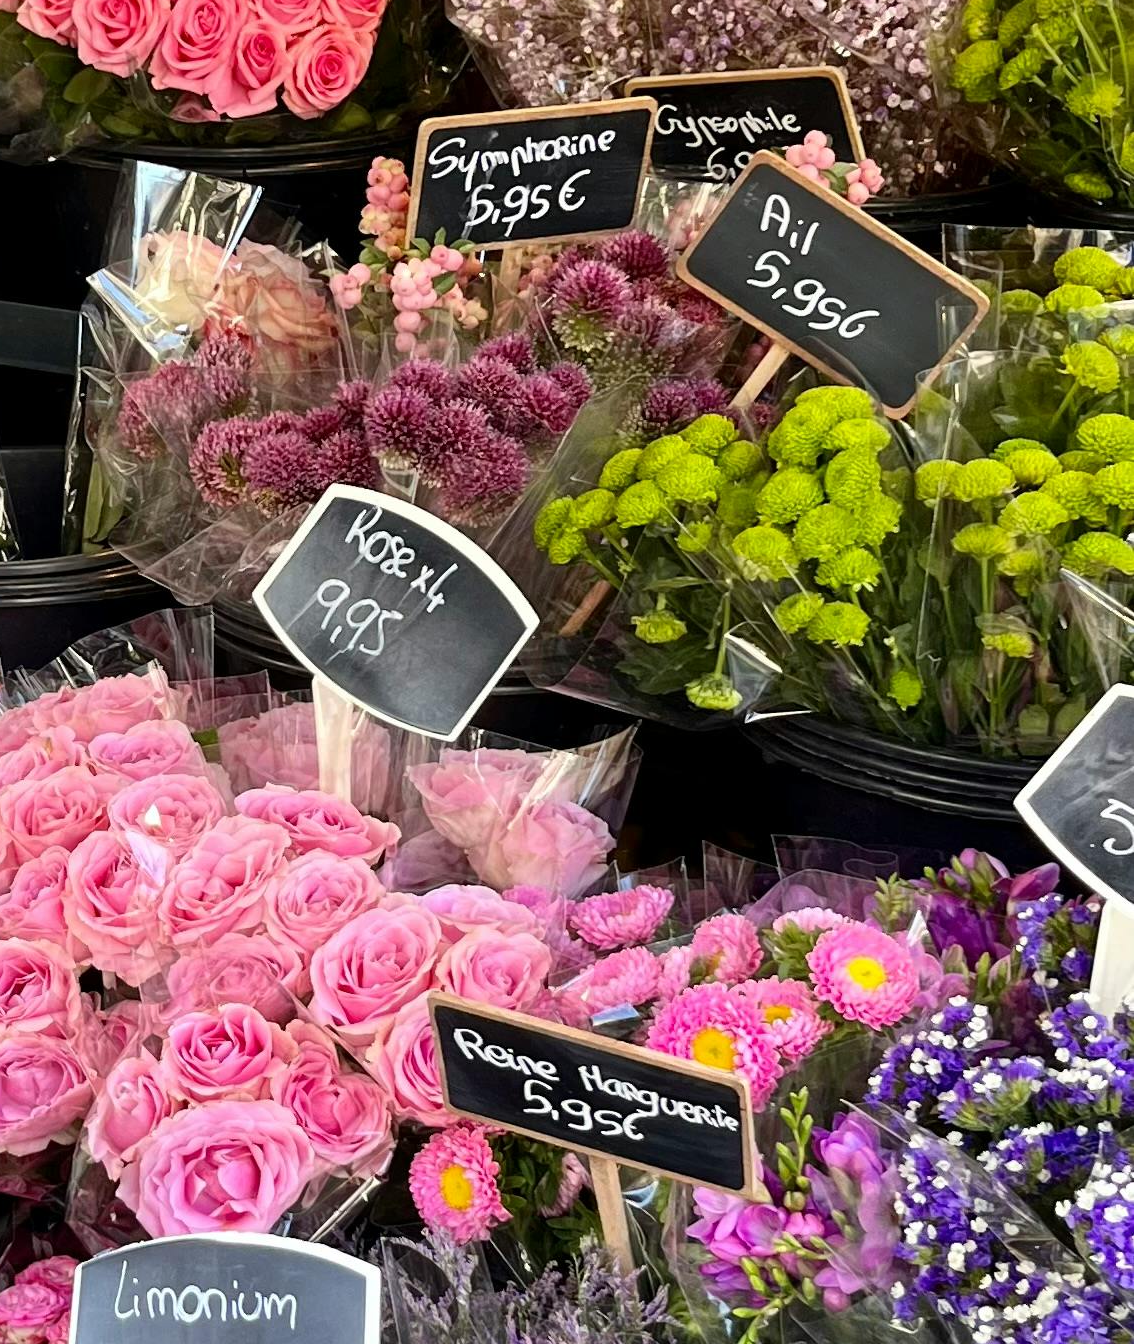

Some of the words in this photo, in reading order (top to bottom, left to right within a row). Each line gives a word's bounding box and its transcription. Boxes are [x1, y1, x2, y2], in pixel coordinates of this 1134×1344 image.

[655, 103, 802, 148] Gypsophile
[760, 193, 820, 256] Ail
[345, 506, 416, 579] Rose
[410, 562, 459, 613] x4
[316, 578, 404, 657] 9,95
[453, 1027, 560, 1081] Reine
[115, 1259, 298, 1330] Limonium
